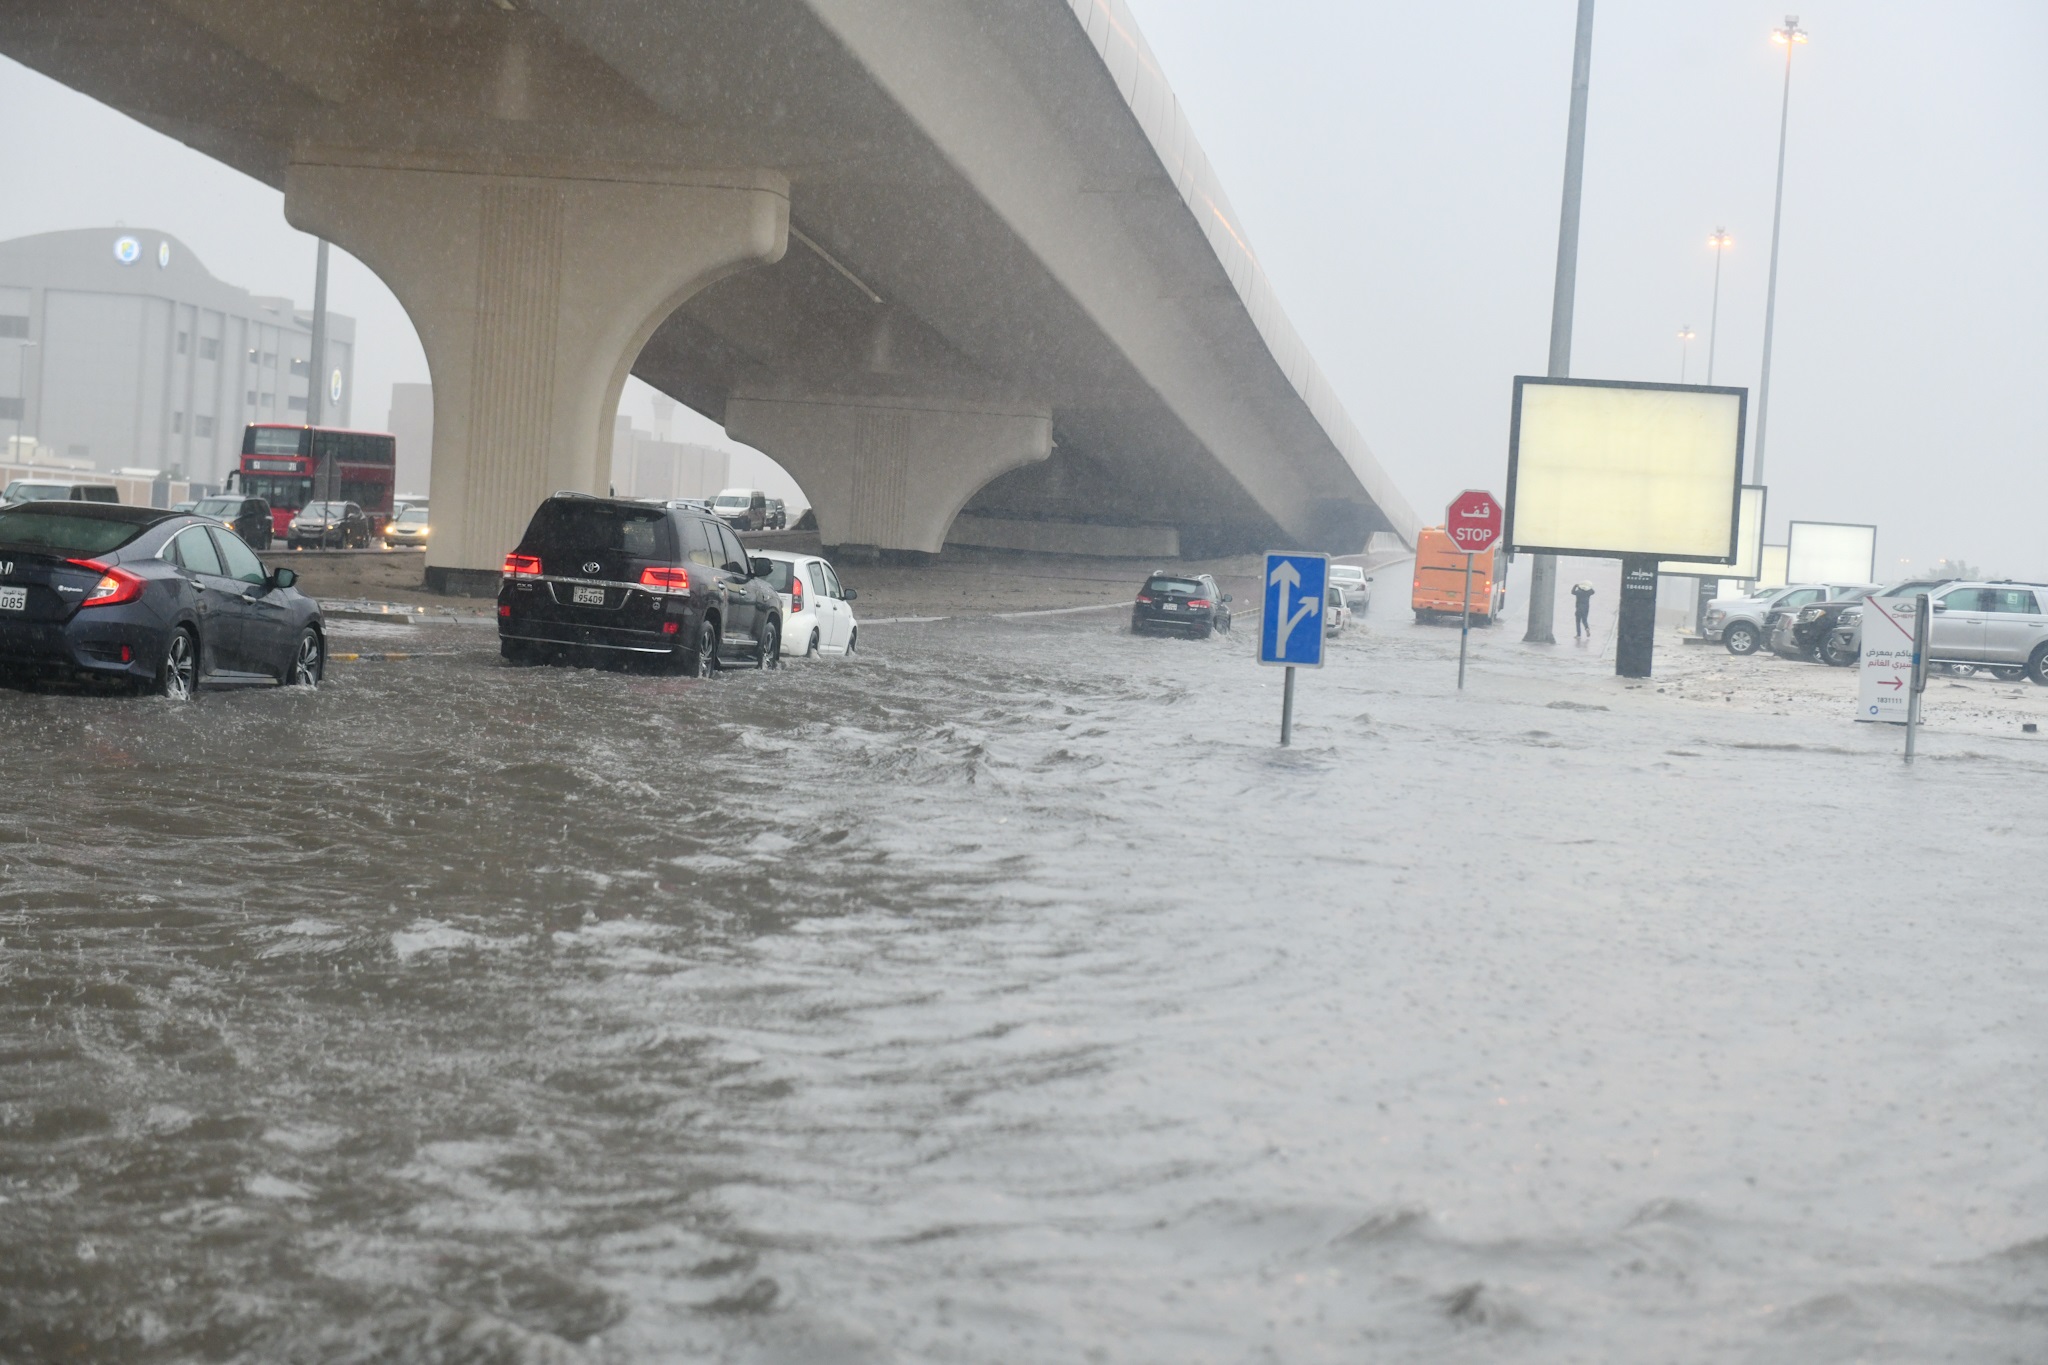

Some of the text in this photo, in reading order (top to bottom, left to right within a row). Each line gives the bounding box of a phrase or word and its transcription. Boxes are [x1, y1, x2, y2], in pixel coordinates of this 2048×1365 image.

[1461, 502, 1490, 519] قف
[1456, 527, 1492, 542] STOP
[1, 597, 24, 609] 085
[1866, 649, 1893, 658] بمعرض
[1868, 659, 1890, 668] الغانم
